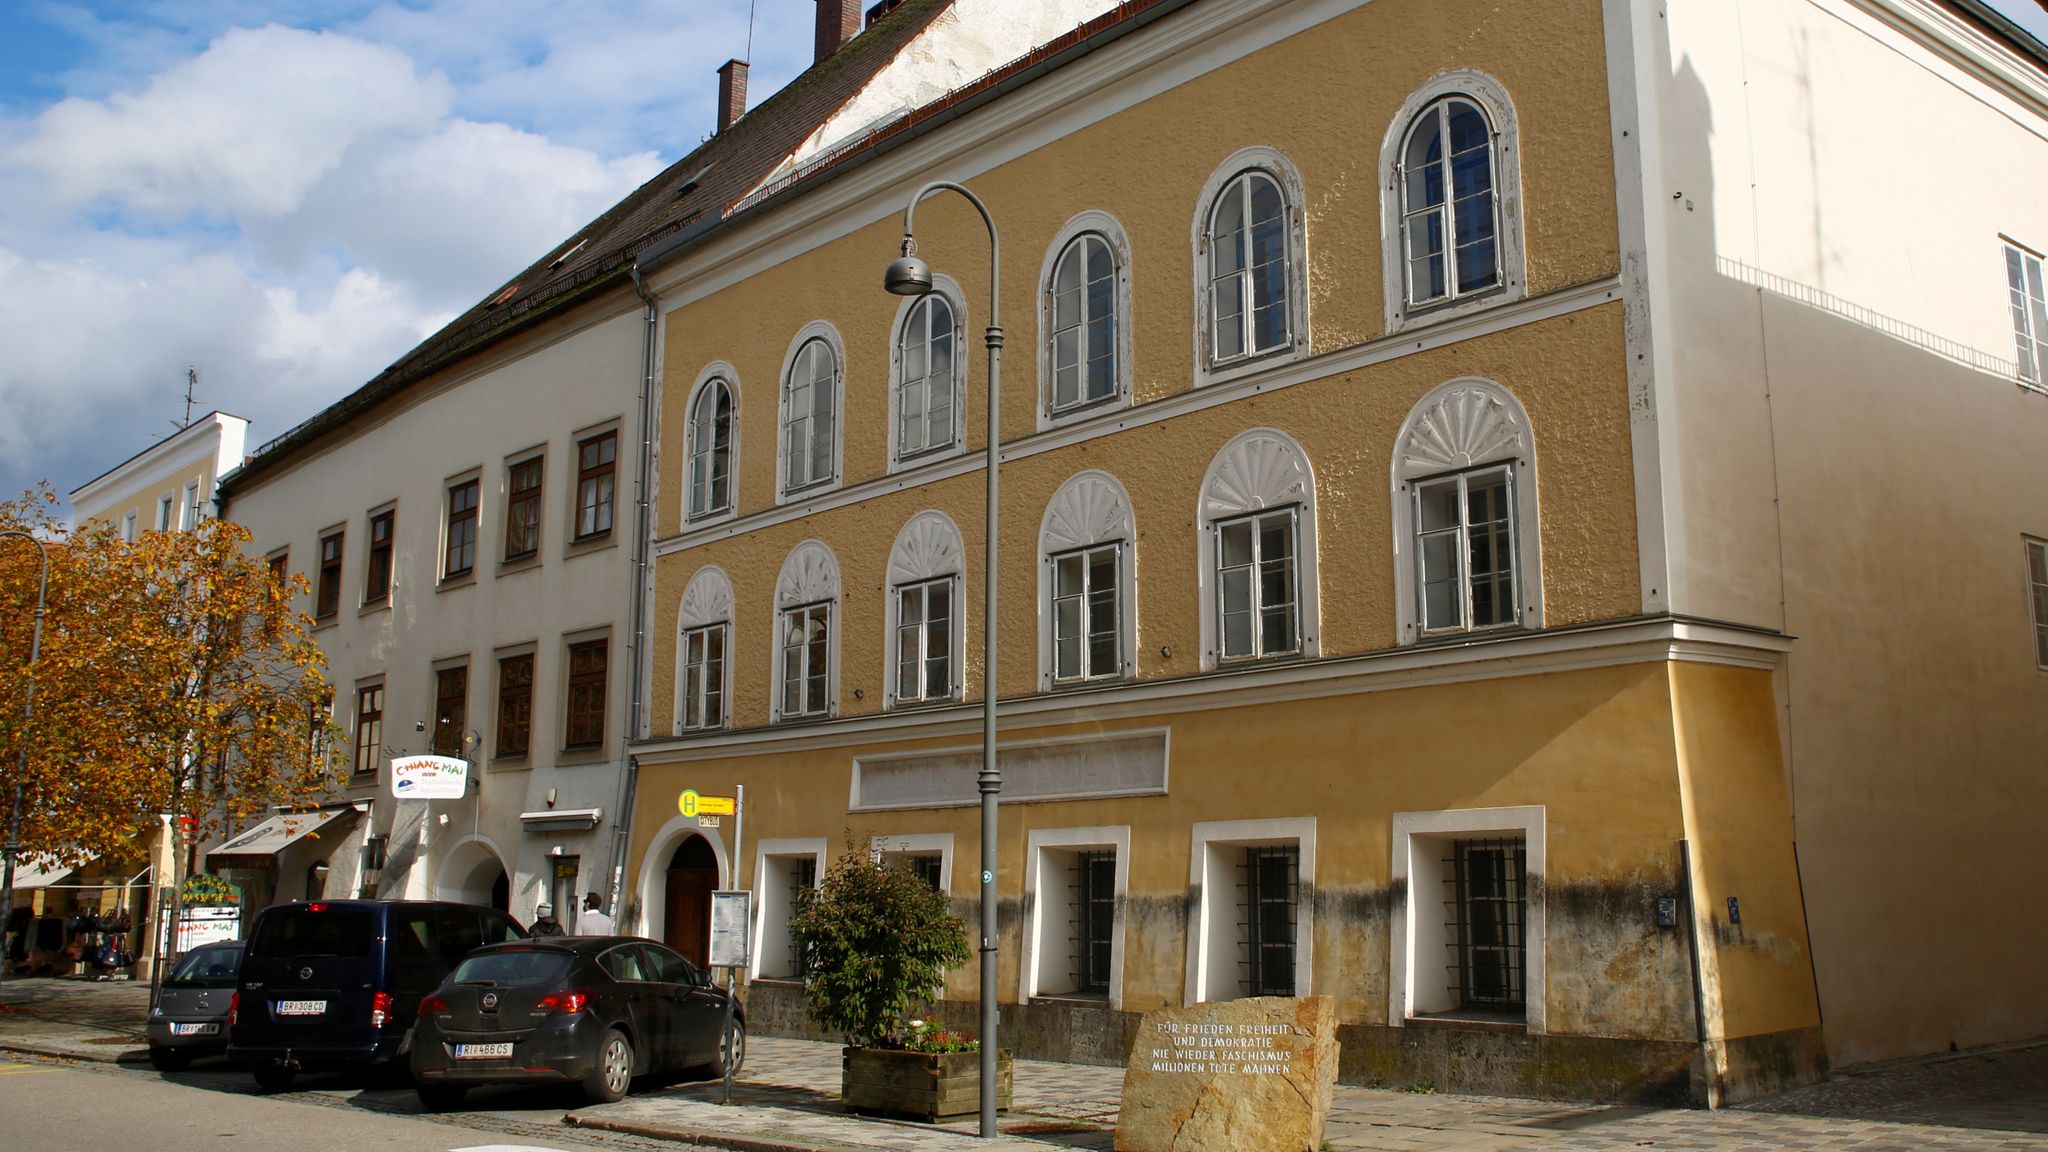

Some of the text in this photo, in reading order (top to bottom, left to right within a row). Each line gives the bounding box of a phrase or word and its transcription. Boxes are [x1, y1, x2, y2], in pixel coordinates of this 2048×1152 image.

[396, 760, 463, 776] CHIANG MAI
[685, 795, 695, 813] H
[183, 893, 224, 902] PASSAGE
[212, 922, 233, 931] MAI
[284, 1002, 294, 1011] BR
[1157, 1021, 1289, 1035] FÜR FRIEDEN FREIHEIT
[1173, 1036, 1273, 1048] UND DEMOKRATIE
[480, 1045, 495, 1055] 466
[497, 1044, 508, 1055] CS
[1152, 1049, 1292, 1061] NIE WIEDER FASCHISMUS
[1151, 1061, 1290, 1075] MILLIONEN TOTE MAHNEN
